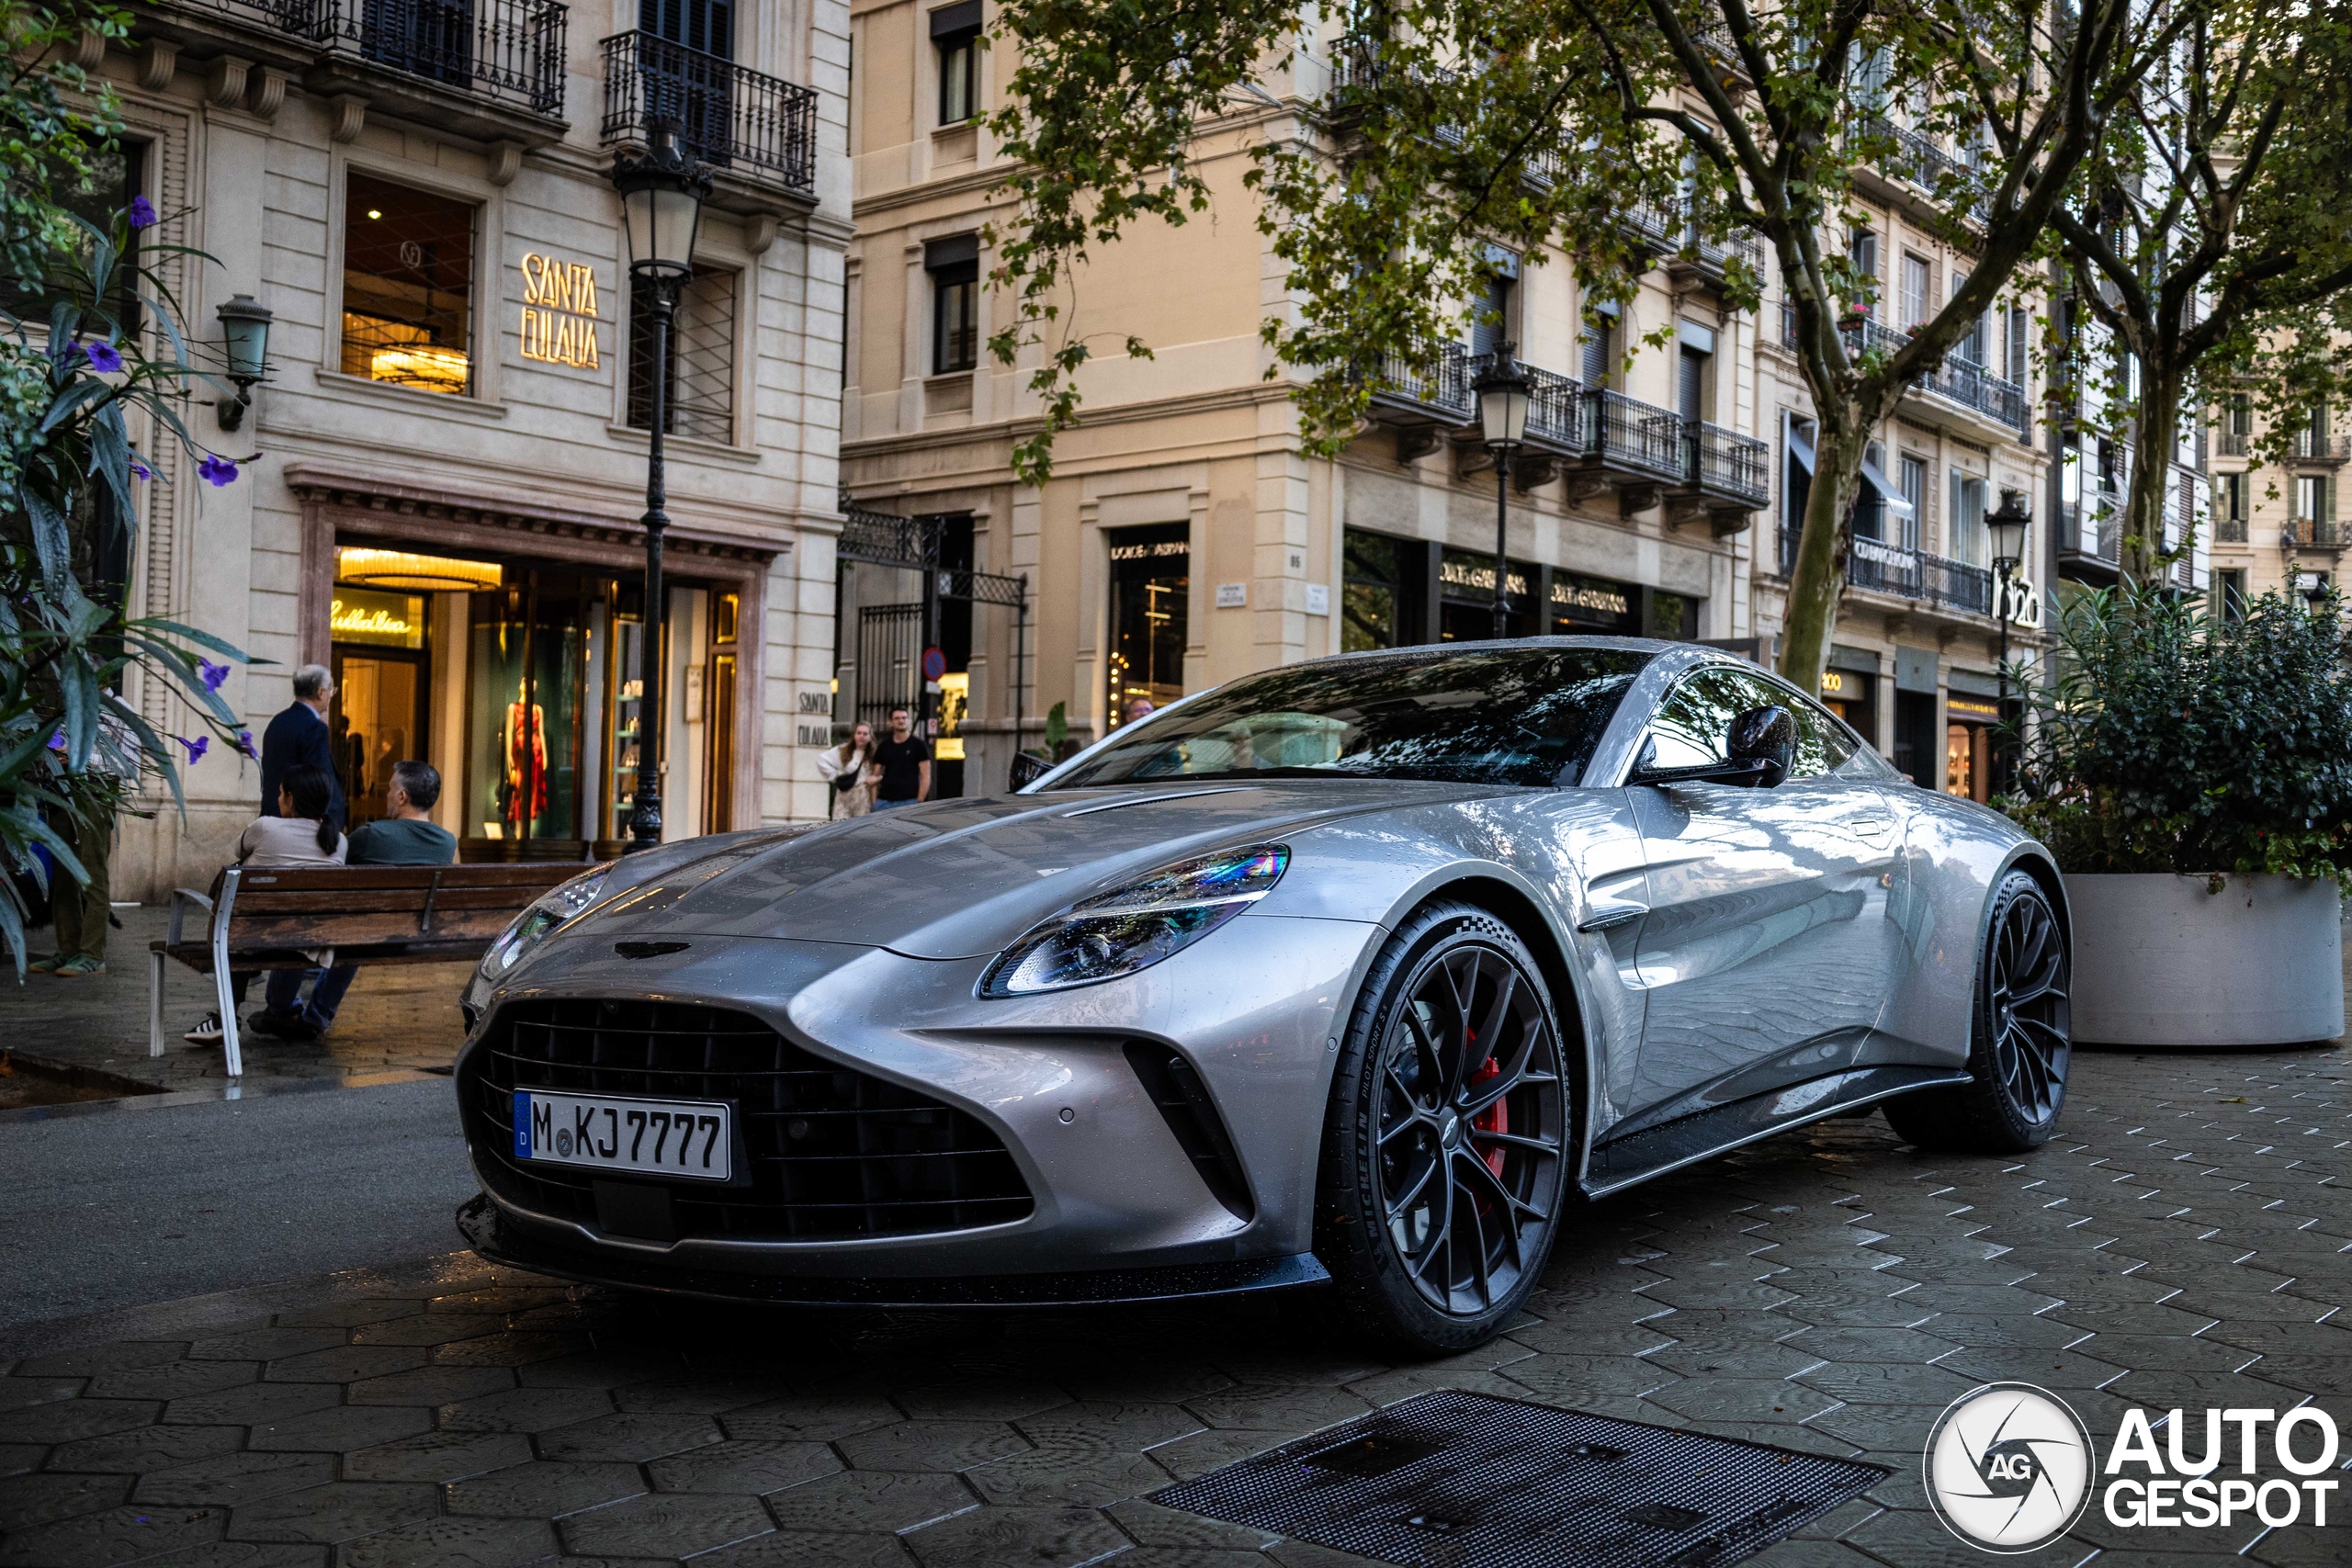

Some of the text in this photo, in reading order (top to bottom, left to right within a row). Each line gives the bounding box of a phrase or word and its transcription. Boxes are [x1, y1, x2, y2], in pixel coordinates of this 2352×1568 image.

[521, 253, 598, 318] SANTA
[520, 306, 599, 371] EULALIA
[798, 692, 829, 713] SANTA
[797, 723, 829, 746] EULALIA
[1367, 1024, 1383, 1062] SPORT
[1362, 1062, 1373, 1100] PILOT
[519, 1132, 527, 1145] D
[532, 1100, 552, 1152] M
[1358, 1111, 1379, 1238] MICHELIN
